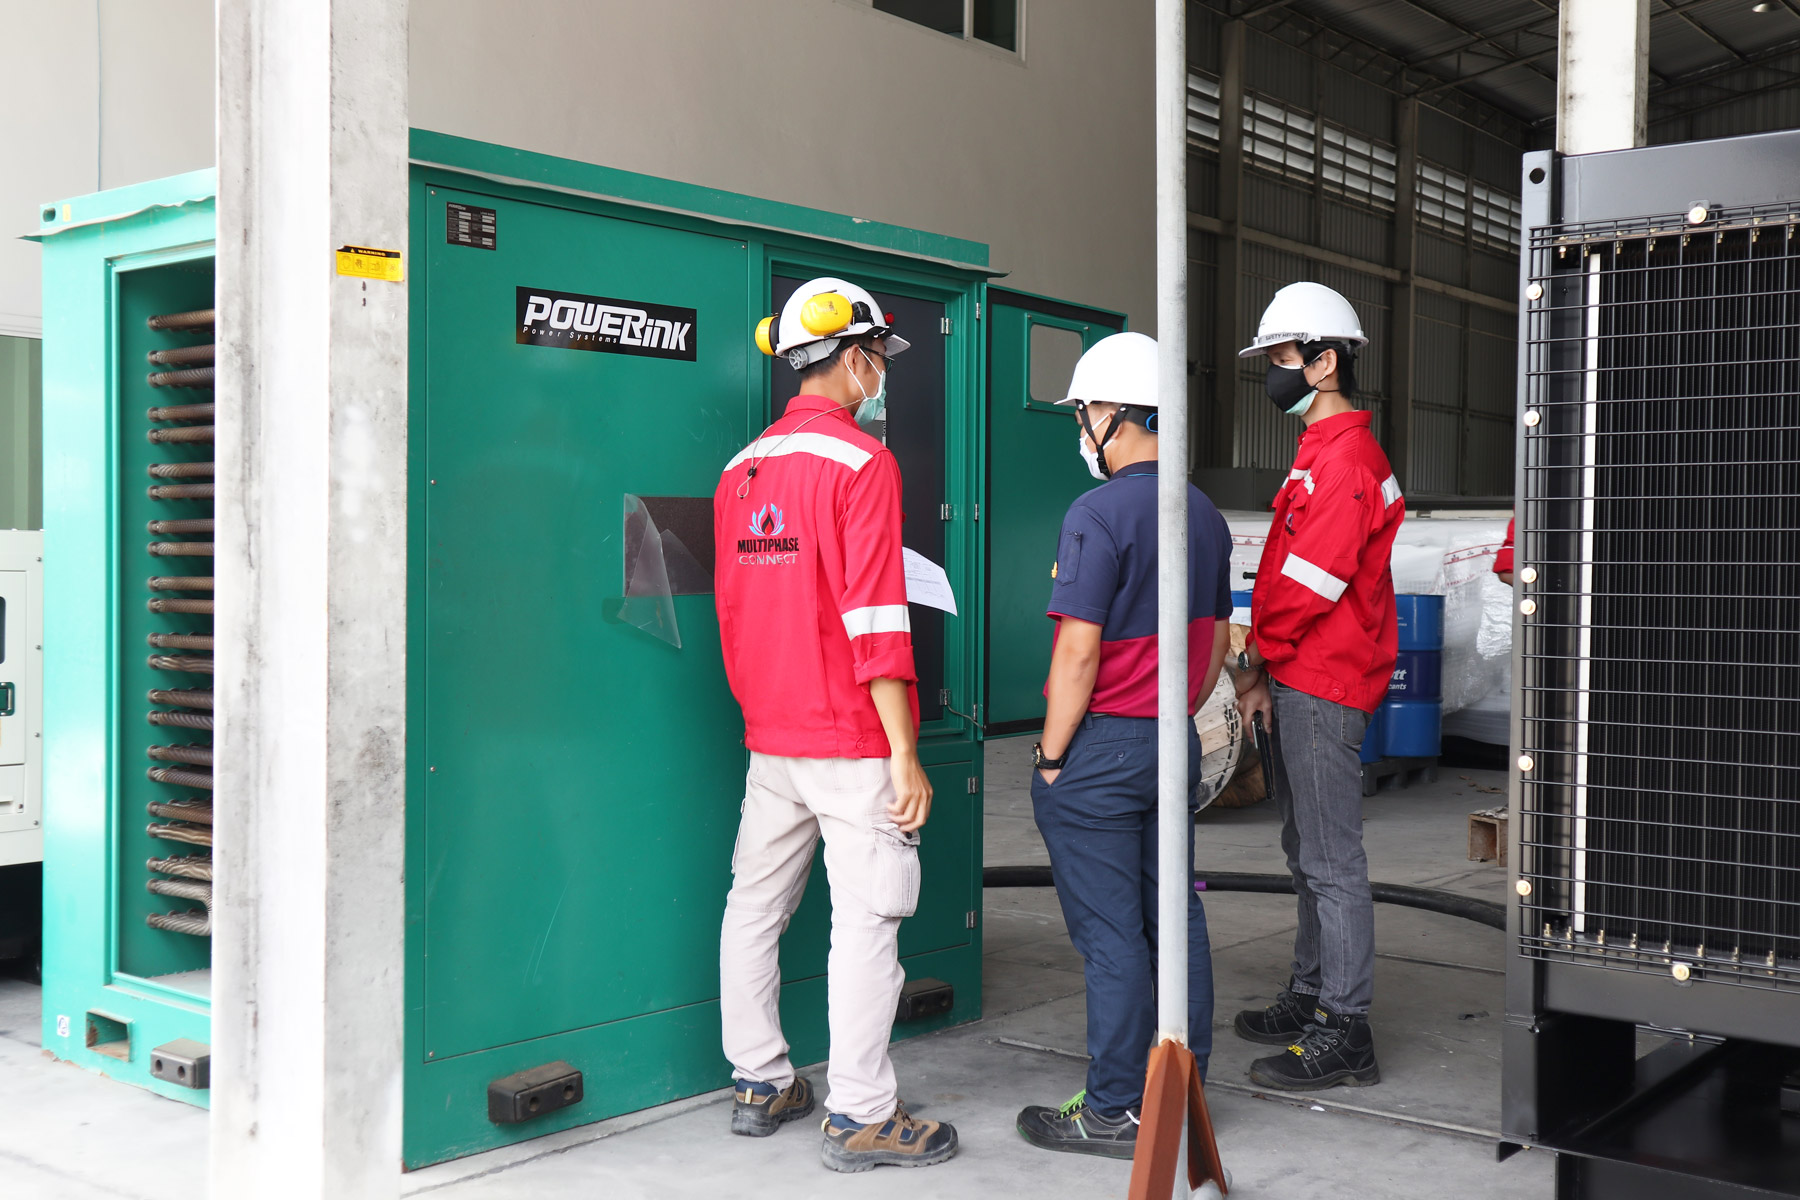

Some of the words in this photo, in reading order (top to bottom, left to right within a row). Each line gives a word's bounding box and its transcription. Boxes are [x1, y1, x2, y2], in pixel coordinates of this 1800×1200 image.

[357, 249, 386, 257] WARNING
[522, 326, 561, 337] Power
[569, 331, 617, 344] Systems
[737, 537, 799, 553] MULTIPHASE
[738, 554, 798, 565] CONNECT
